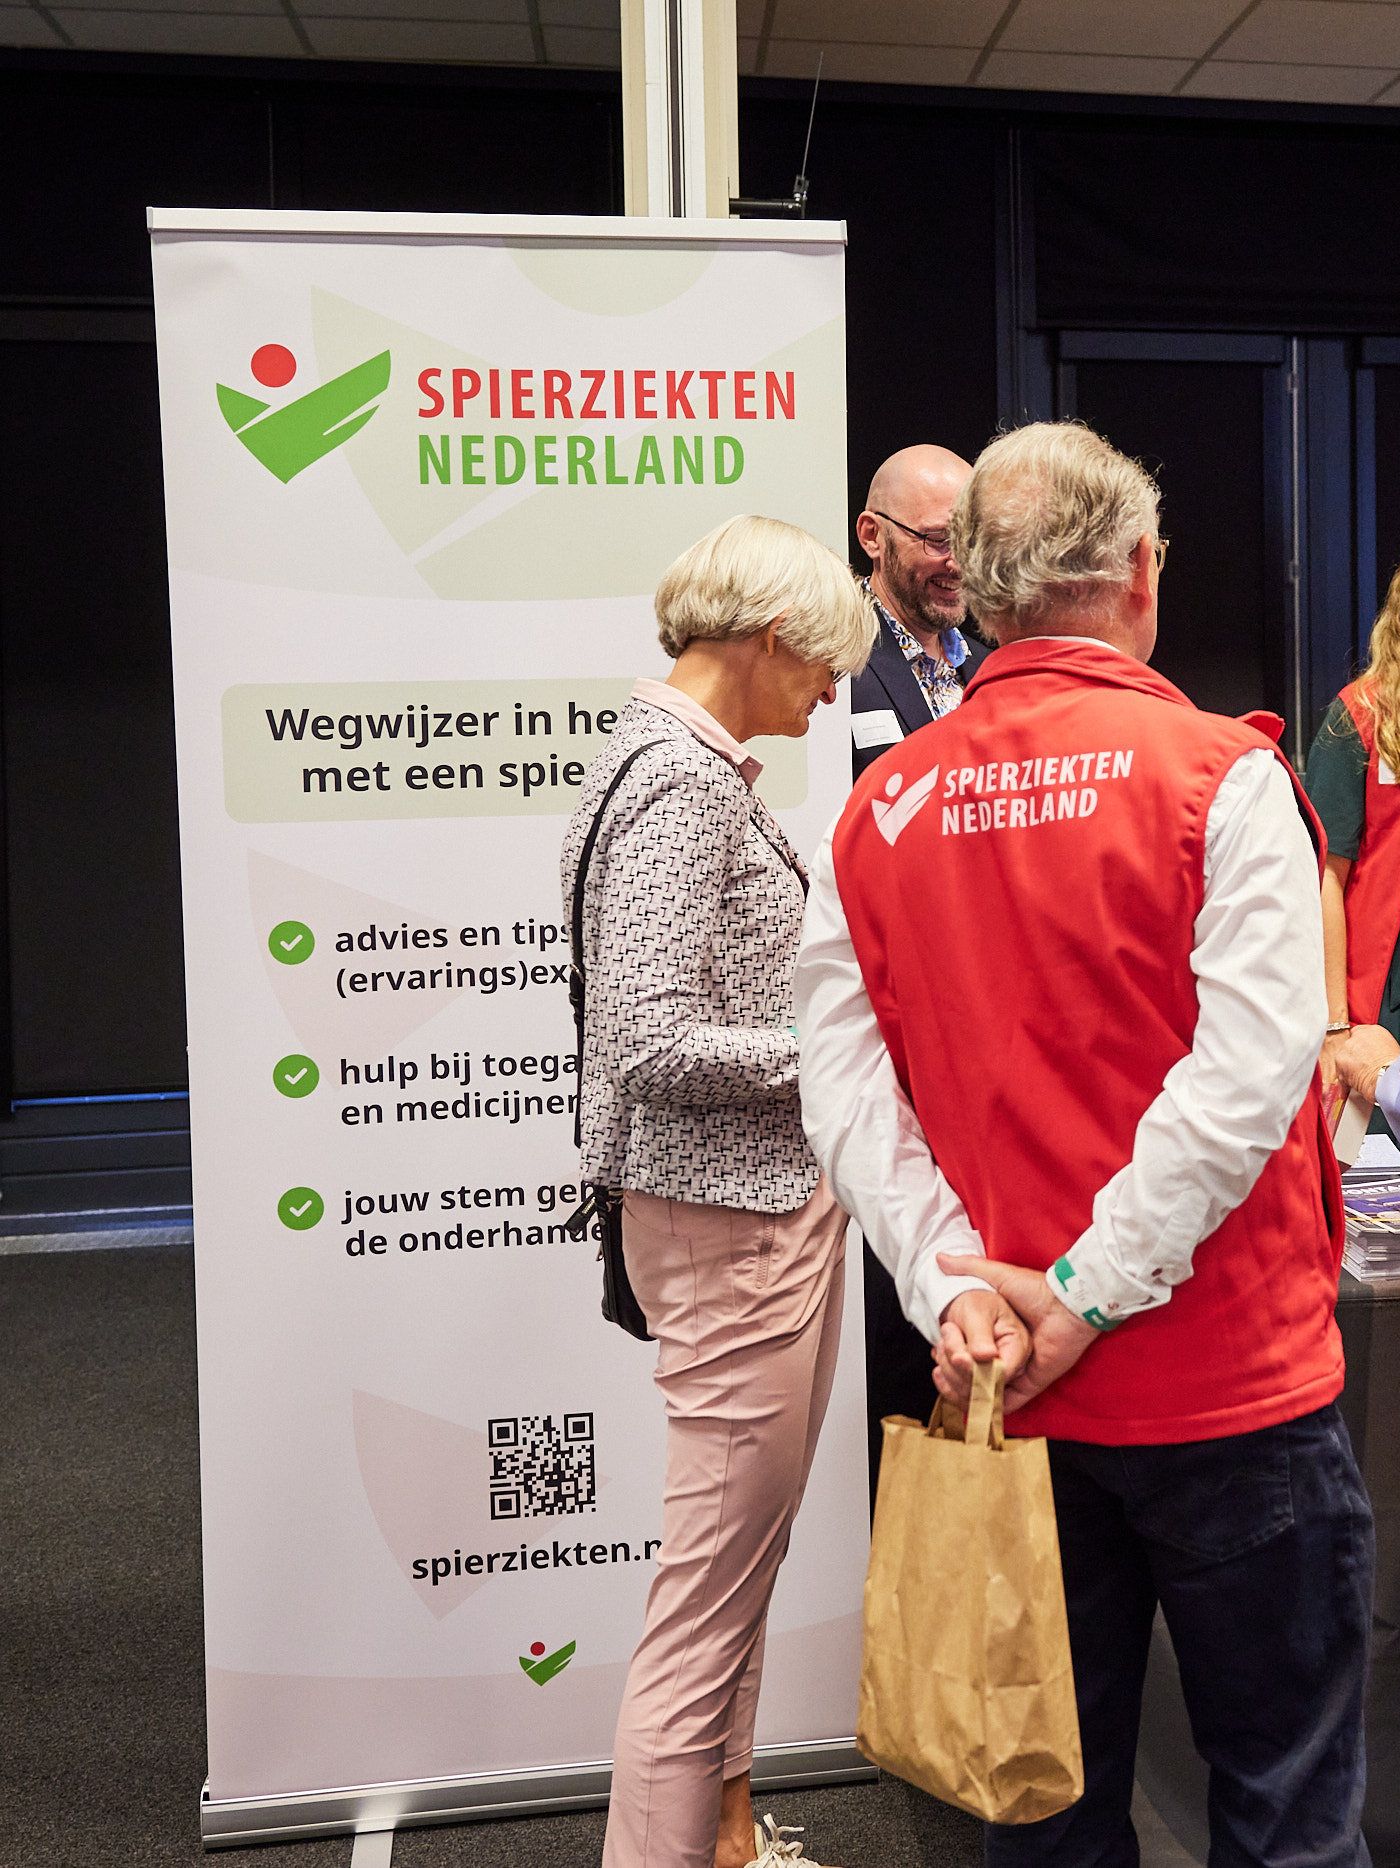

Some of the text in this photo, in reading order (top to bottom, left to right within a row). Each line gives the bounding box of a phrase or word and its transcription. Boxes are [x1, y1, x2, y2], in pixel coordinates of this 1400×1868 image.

[417, 367, 797, 421] SPIERZIEKTEN
[418, 434, 745, 486] NEDERLAND
[266, 701, 618, 751] Wegwijzer in he
[303, 752, 585, 797] met een spie
[943, 750, 1134, 799] SPIERZIEKTEN
[942, 787, 1098, 836] NEDERLAND
[335, 923, 448, 953] advies
[459, 926, 500, 947] en
[336, 960, 569, 998] (ervarings)ex
[340, 1051, 579, 1090] hulp bij toega
[341, 1104, 383, 1126] en
[340, 1190, 430, 1225] jouw
[440, 1185, 525, 1211] stem
[345, 1230, 388, 1257] de
